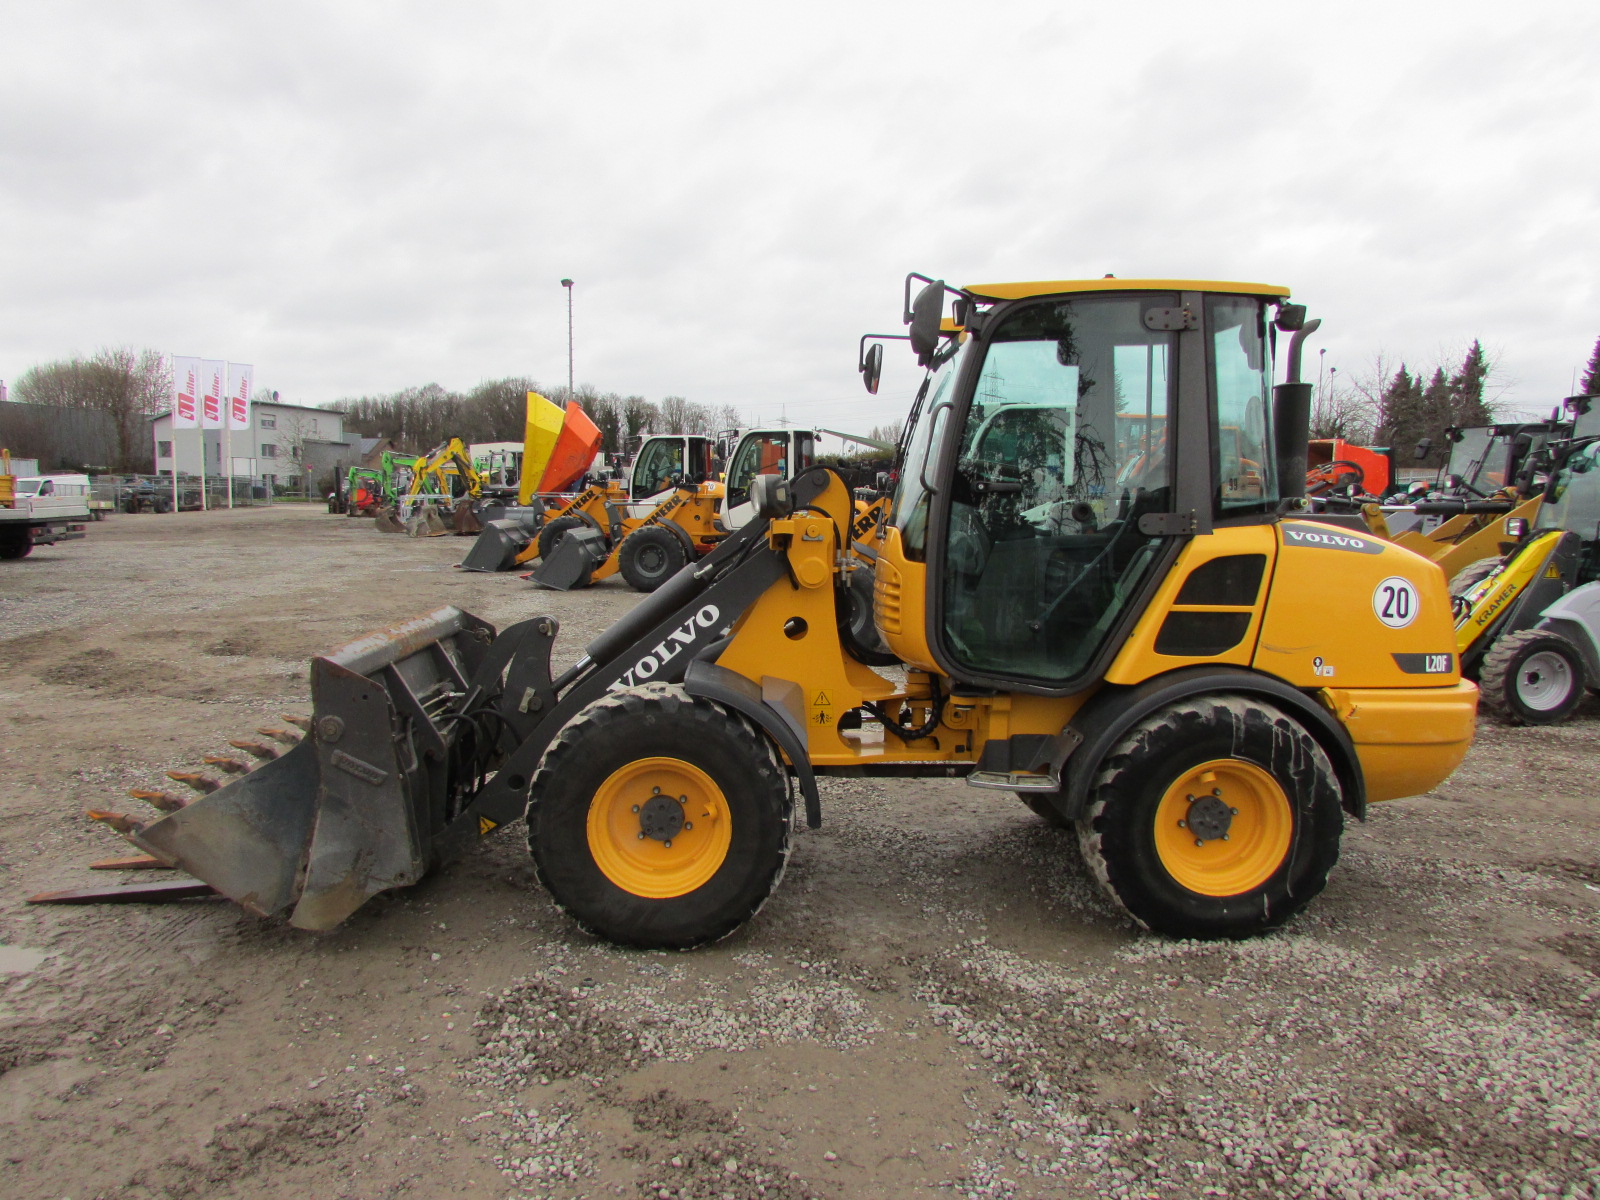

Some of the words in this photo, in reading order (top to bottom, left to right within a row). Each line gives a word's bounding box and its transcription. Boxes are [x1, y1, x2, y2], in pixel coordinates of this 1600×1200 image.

[641, 494, 683, 526] BHERR
[851, 506, 882, 541] ERR
[1286, 530, 1364, 548] VOLVO
[1382, 586, 1409, 619] 20
[1475, 583, 1518, 627] KRAMER
[606, 604, 720, 690] VOLVO
[1425, 655, 1447, 673] L20F
